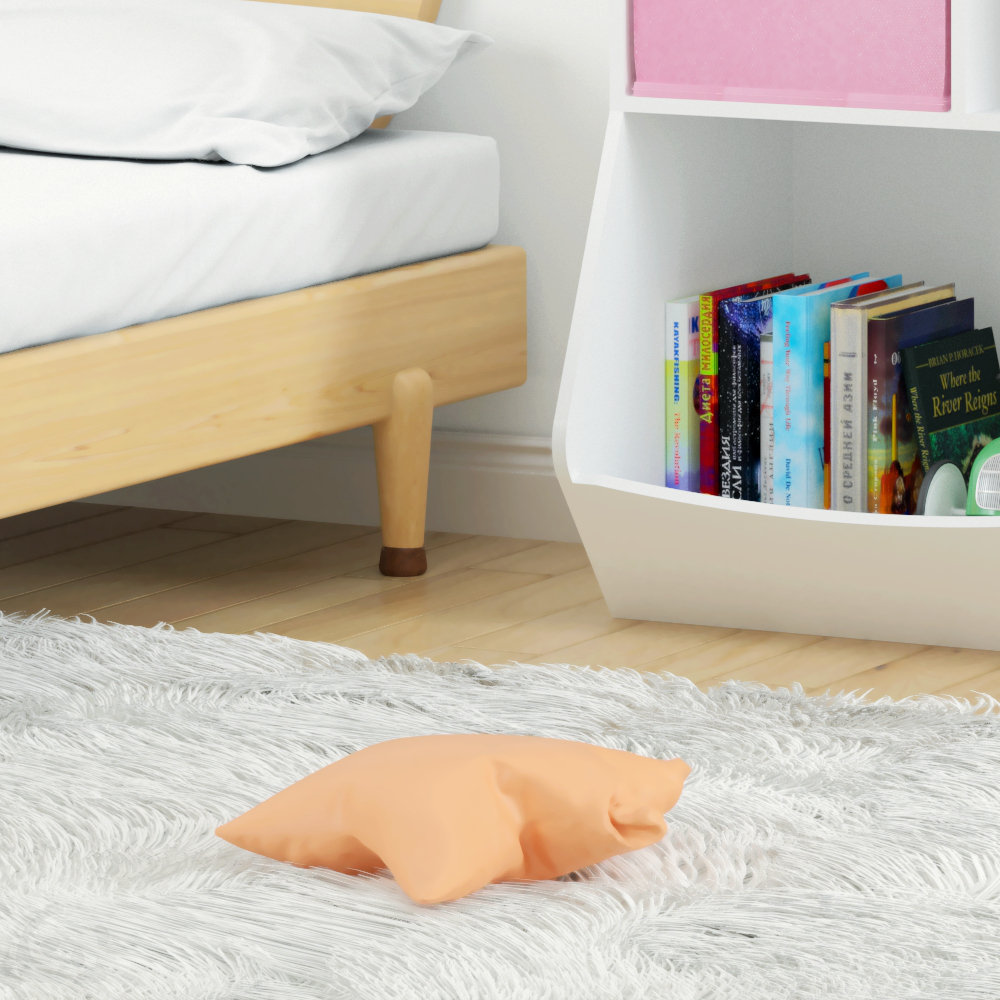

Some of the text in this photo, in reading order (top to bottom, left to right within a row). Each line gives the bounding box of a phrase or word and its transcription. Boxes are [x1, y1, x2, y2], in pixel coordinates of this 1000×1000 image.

[928, 354, 948, 368] BRIAN
[939, 365, 981, 390] Where the
[700, 377, 713, 423] Диета
[843, 371, 853, 413] АЗИИ
[932, 389, 998, 418] River Reigns
[721, 436, 731, 498] ВЕЗДИЯ
[840, 419, 853, 489] СРЕДНЕЙ
[731, 465, 742, 500] СЛИ
